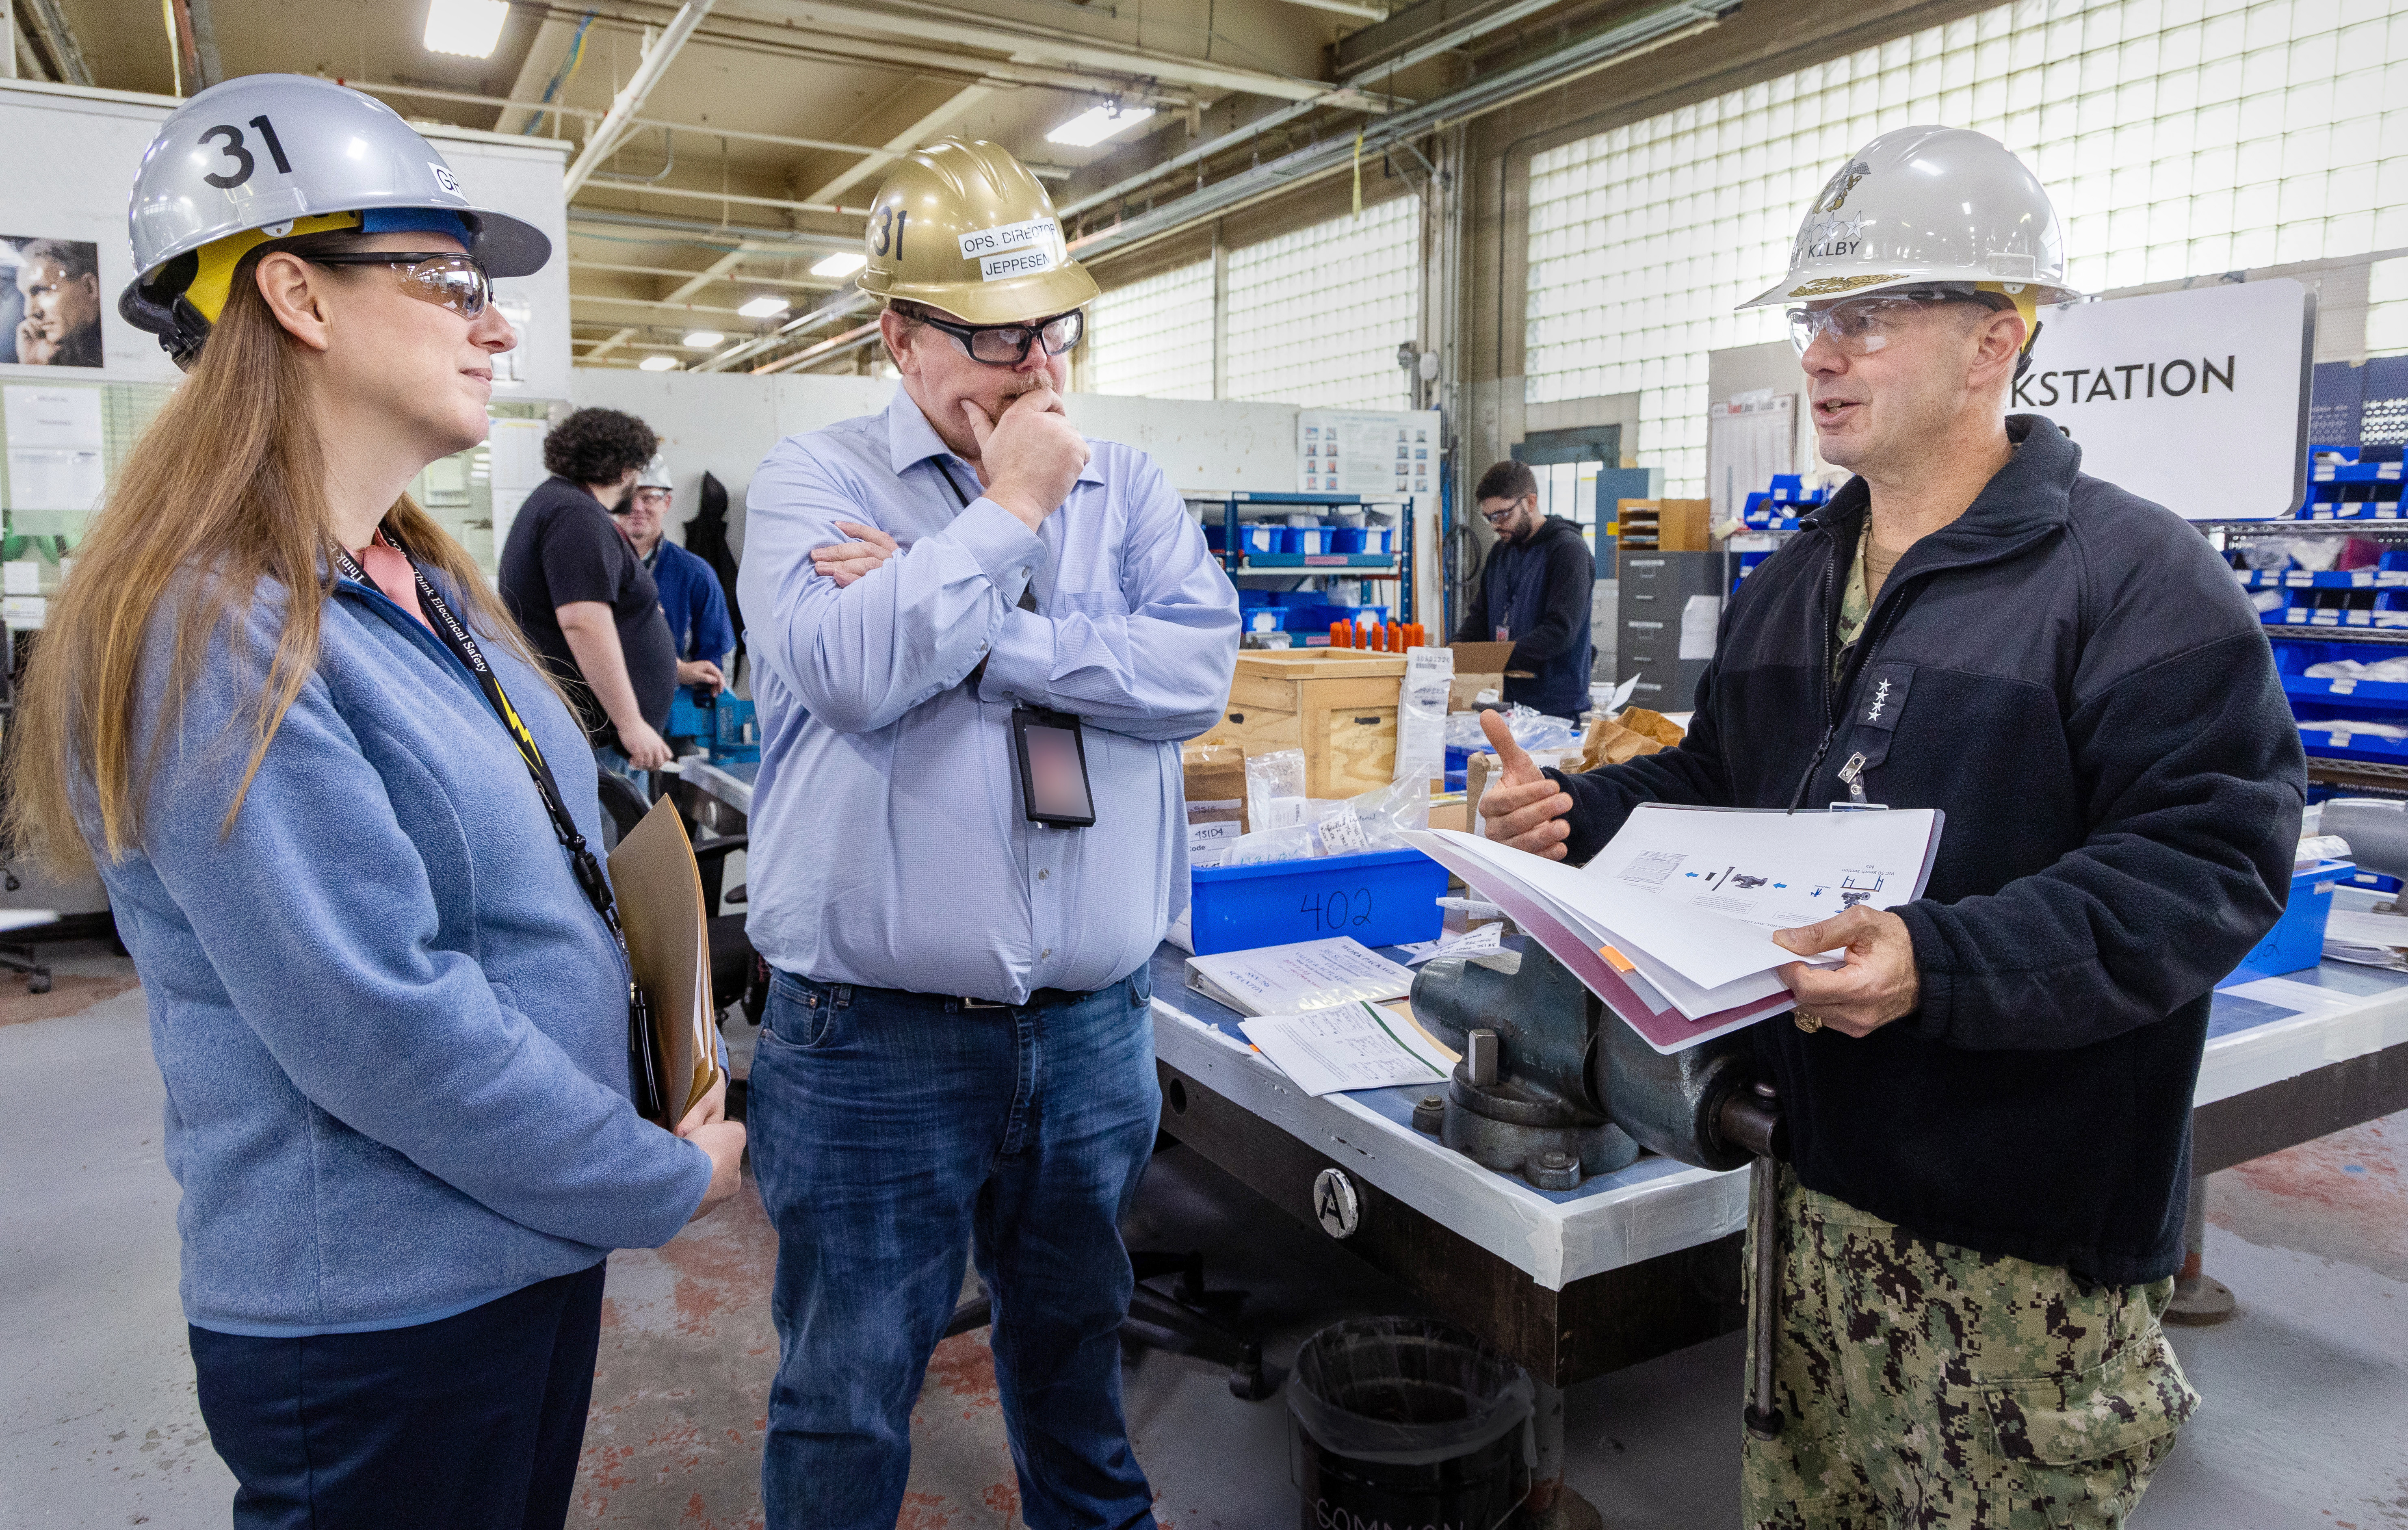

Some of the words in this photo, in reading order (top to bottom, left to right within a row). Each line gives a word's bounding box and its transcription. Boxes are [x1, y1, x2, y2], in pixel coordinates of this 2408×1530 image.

[197, 115, 292, 189] 31
[873, 206, 907, 260] 31
[964, 234, 999, 253] OPS.
[1002, 224, 1055, 244] DIRECTOR
[1808, 241, 1860, 258] KILBY
[985, 253, 1050, 275] JEPPESEN
[2005, 355, 2235, 408] KSTATION
[336, 552, 364, 583] Think
[413, 569, 435, 596] Think
[431, 596, 468, 642] Electrical
[463, 641, 487, 672] Safety
[1301, 888, 1372, 932] 402
[1342, 945, 1364, 958] WORK
[1362, 957, 1399, 975] PACKAGE
[1228, 970, 1264, 993] SCRANTON
[1320, 1175, 1345, 1230] A
